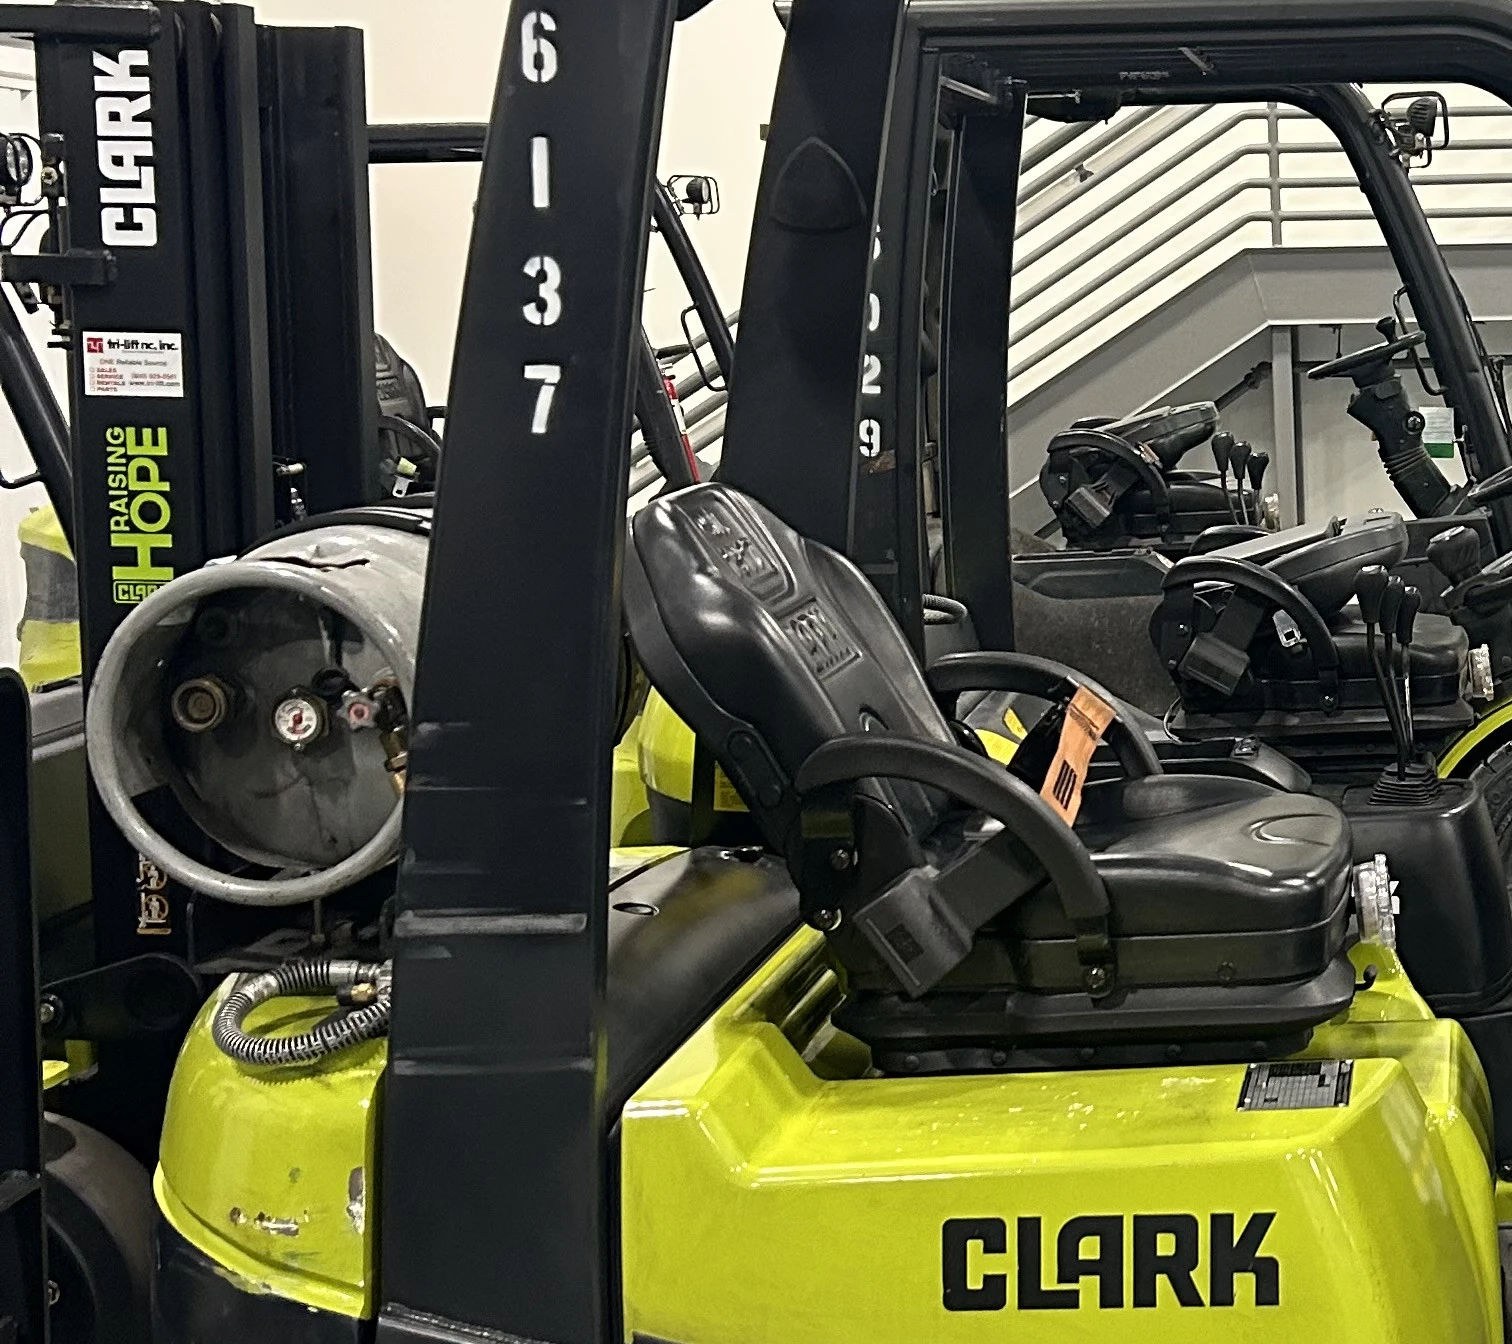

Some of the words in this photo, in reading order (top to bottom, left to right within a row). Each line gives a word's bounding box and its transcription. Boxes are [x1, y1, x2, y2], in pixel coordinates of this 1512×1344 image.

[92, 50, 158, 247] CLARK
[521, 10, 563, 434] 6137
[105, 426, 131, 532] RAISING
[110, 427, 174, 581] HOPE
[117, 584, 158, 601] CLAR
[942, 1212, 1280, 1312] CLARK
